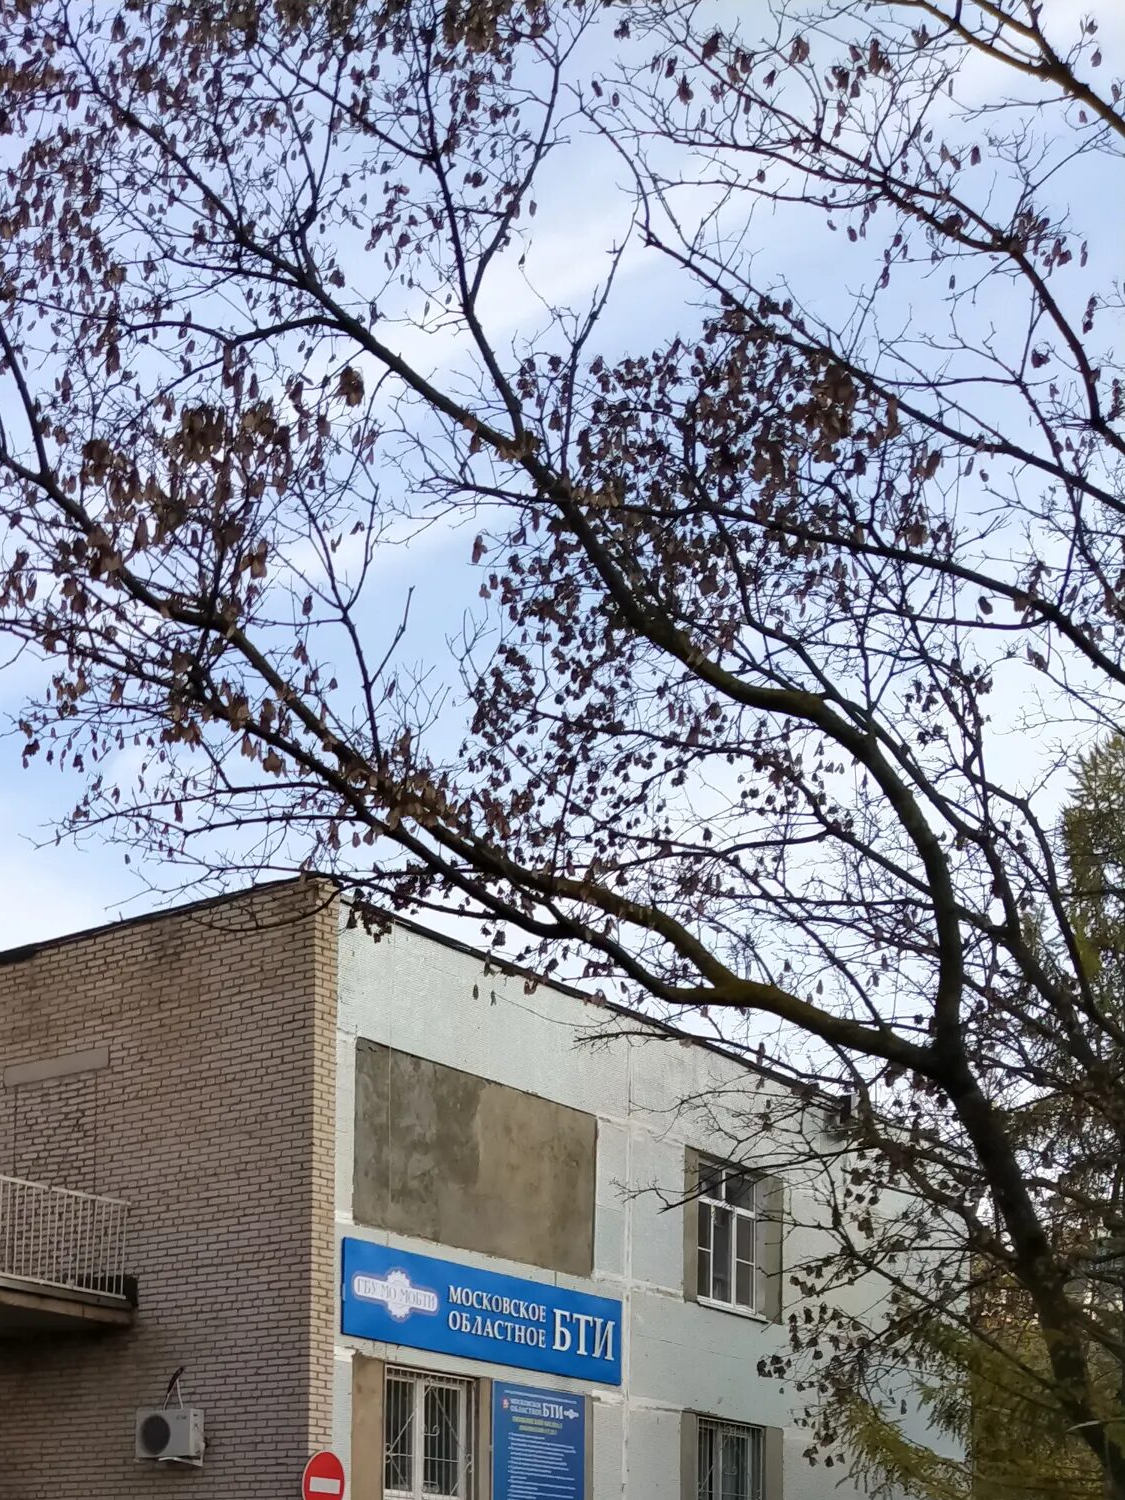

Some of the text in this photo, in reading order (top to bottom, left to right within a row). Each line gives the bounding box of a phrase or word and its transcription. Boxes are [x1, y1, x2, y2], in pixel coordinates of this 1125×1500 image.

[448, 1285, 547, 1323] МОСКОВСКОЕ
[448, 1310, 547, 1348] ОБЛАСТНОЕ
[552, 1308, 616, 1361] БТИ
[542, 1402, 564, 1420] БТИ
